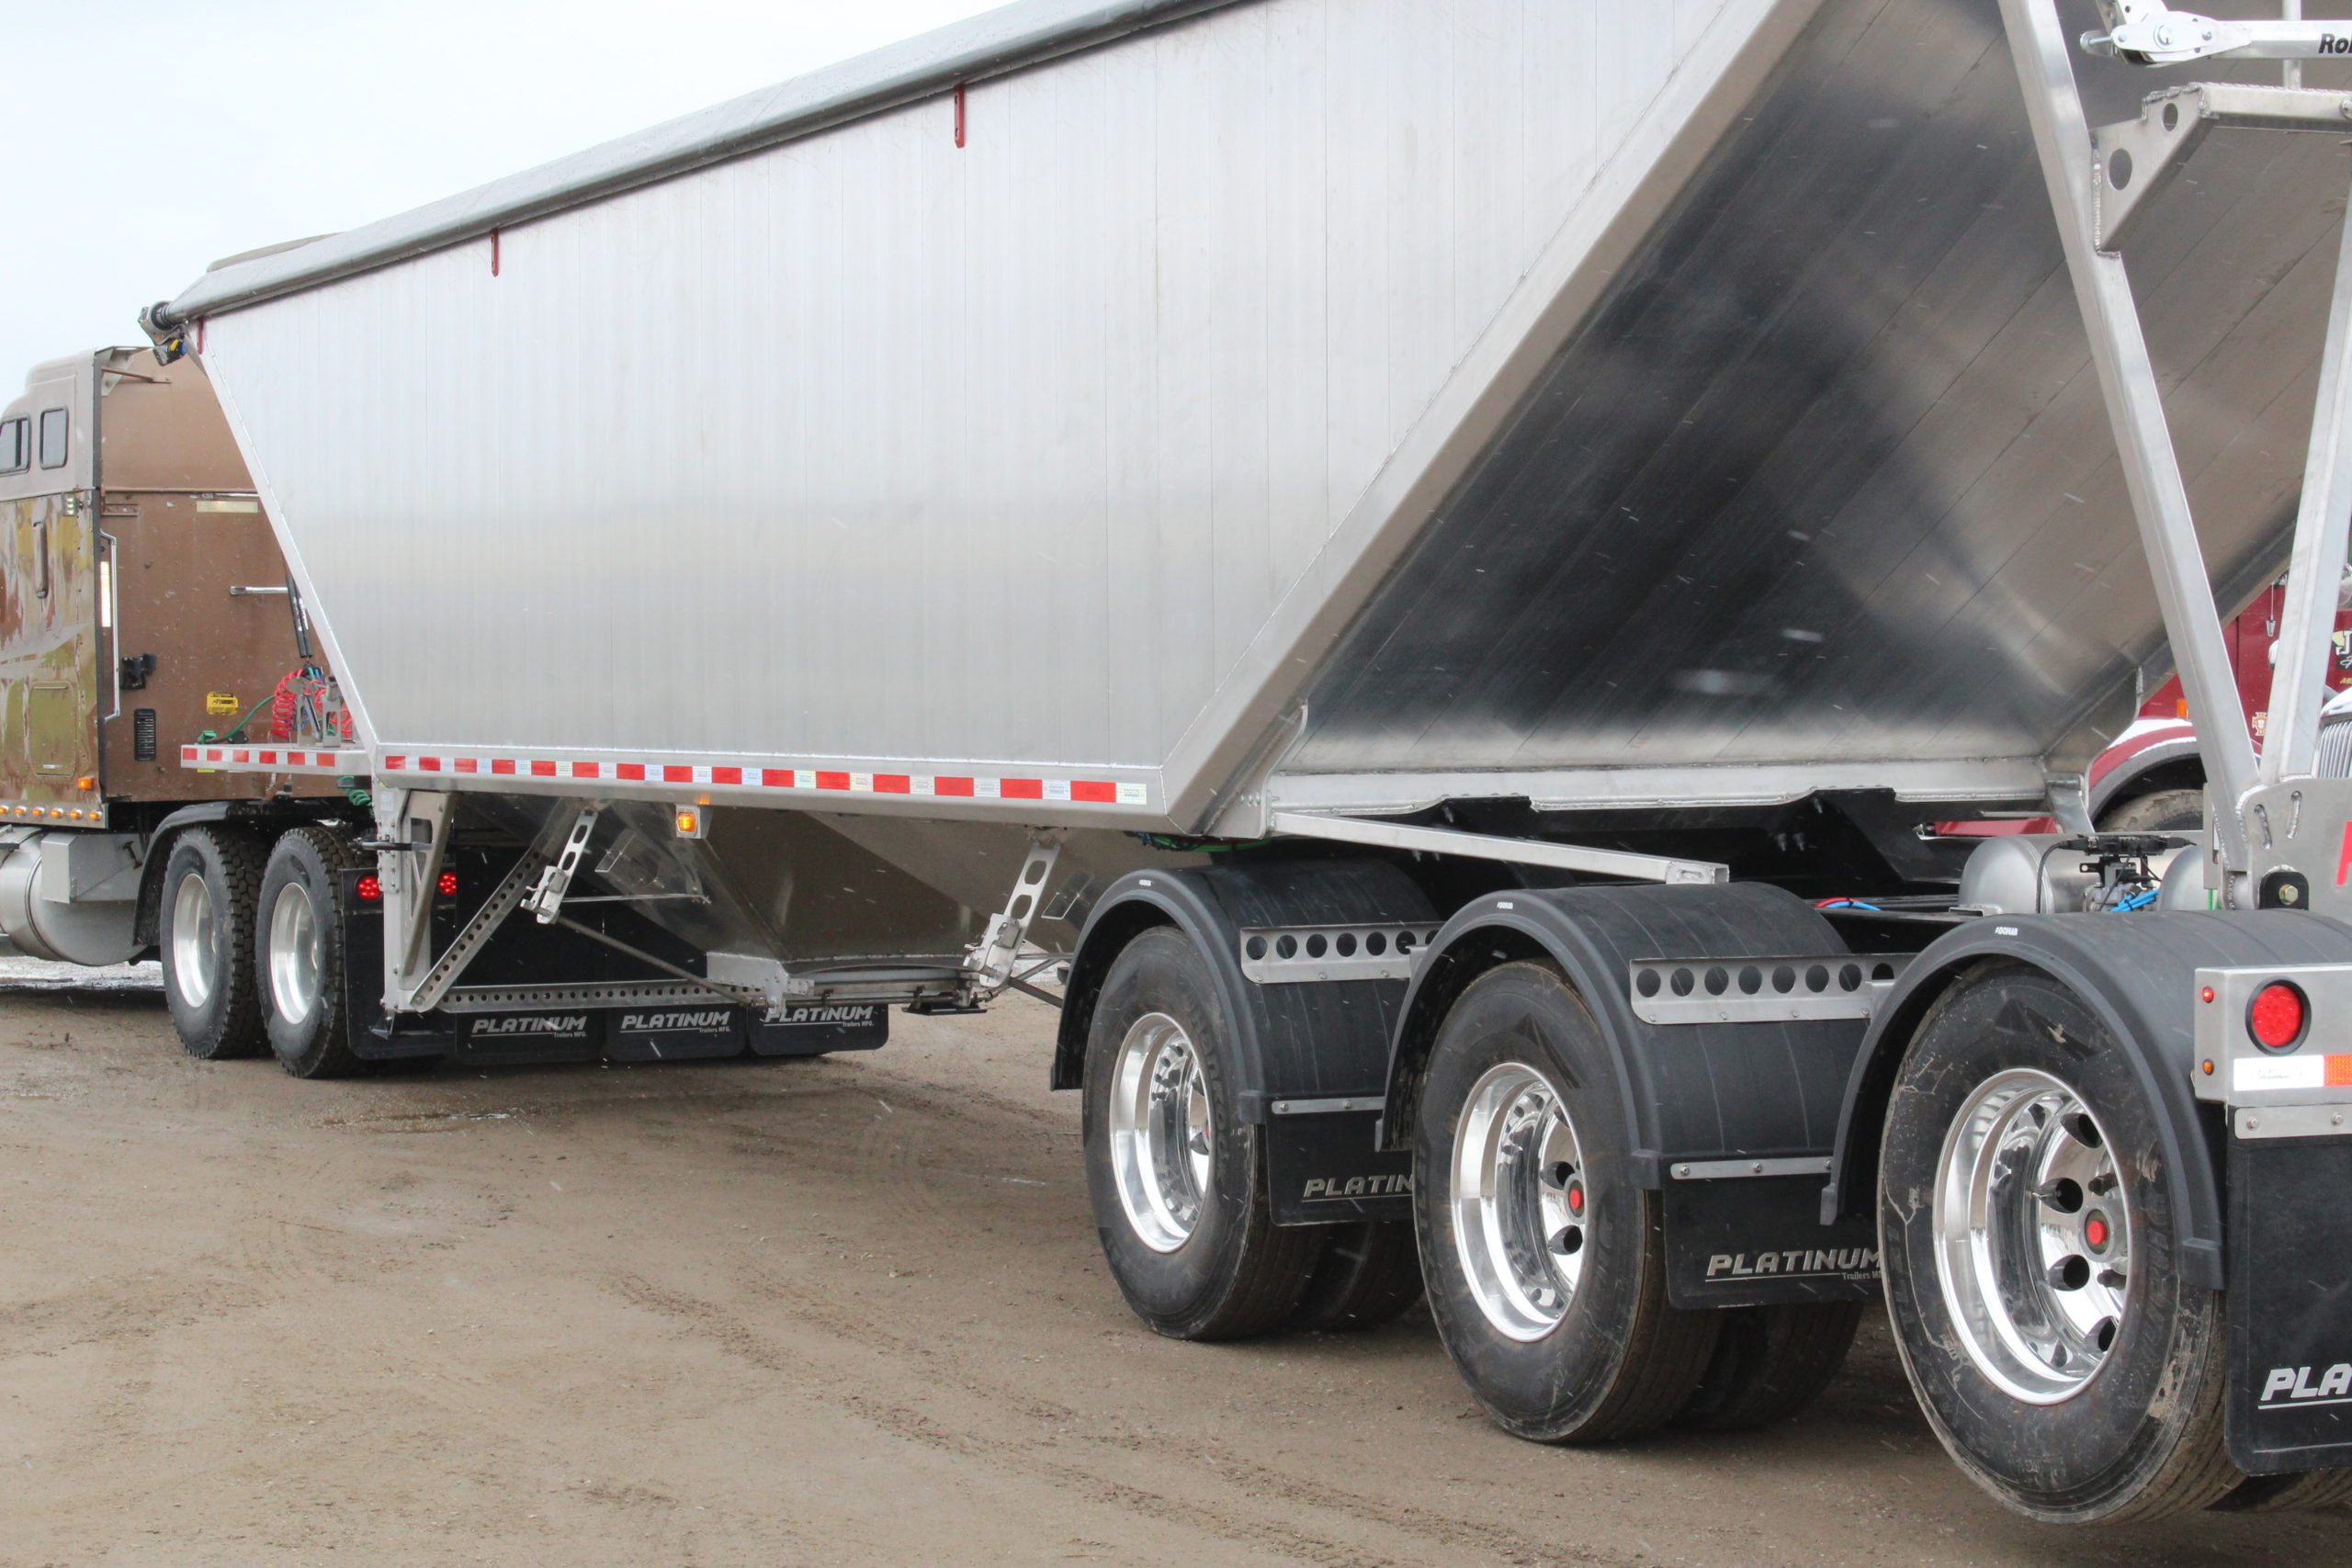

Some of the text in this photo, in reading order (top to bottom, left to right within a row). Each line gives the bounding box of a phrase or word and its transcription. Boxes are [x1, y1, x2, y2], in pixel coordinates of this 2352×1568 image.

[620, 1011, 731, 1029] PLATINUM
[764, 1006, 874, 1022] PLATINUM
[470, 1016, 588, 1033] PLATINUM
[1303, 1173, 1414, 1198] PLATIN
[1706, 1247, 1881, 1277] PLATINUM
[1841, 1271, 1871, 1280] Trailers
[2260, 1363, 2352, 1402] PLA
